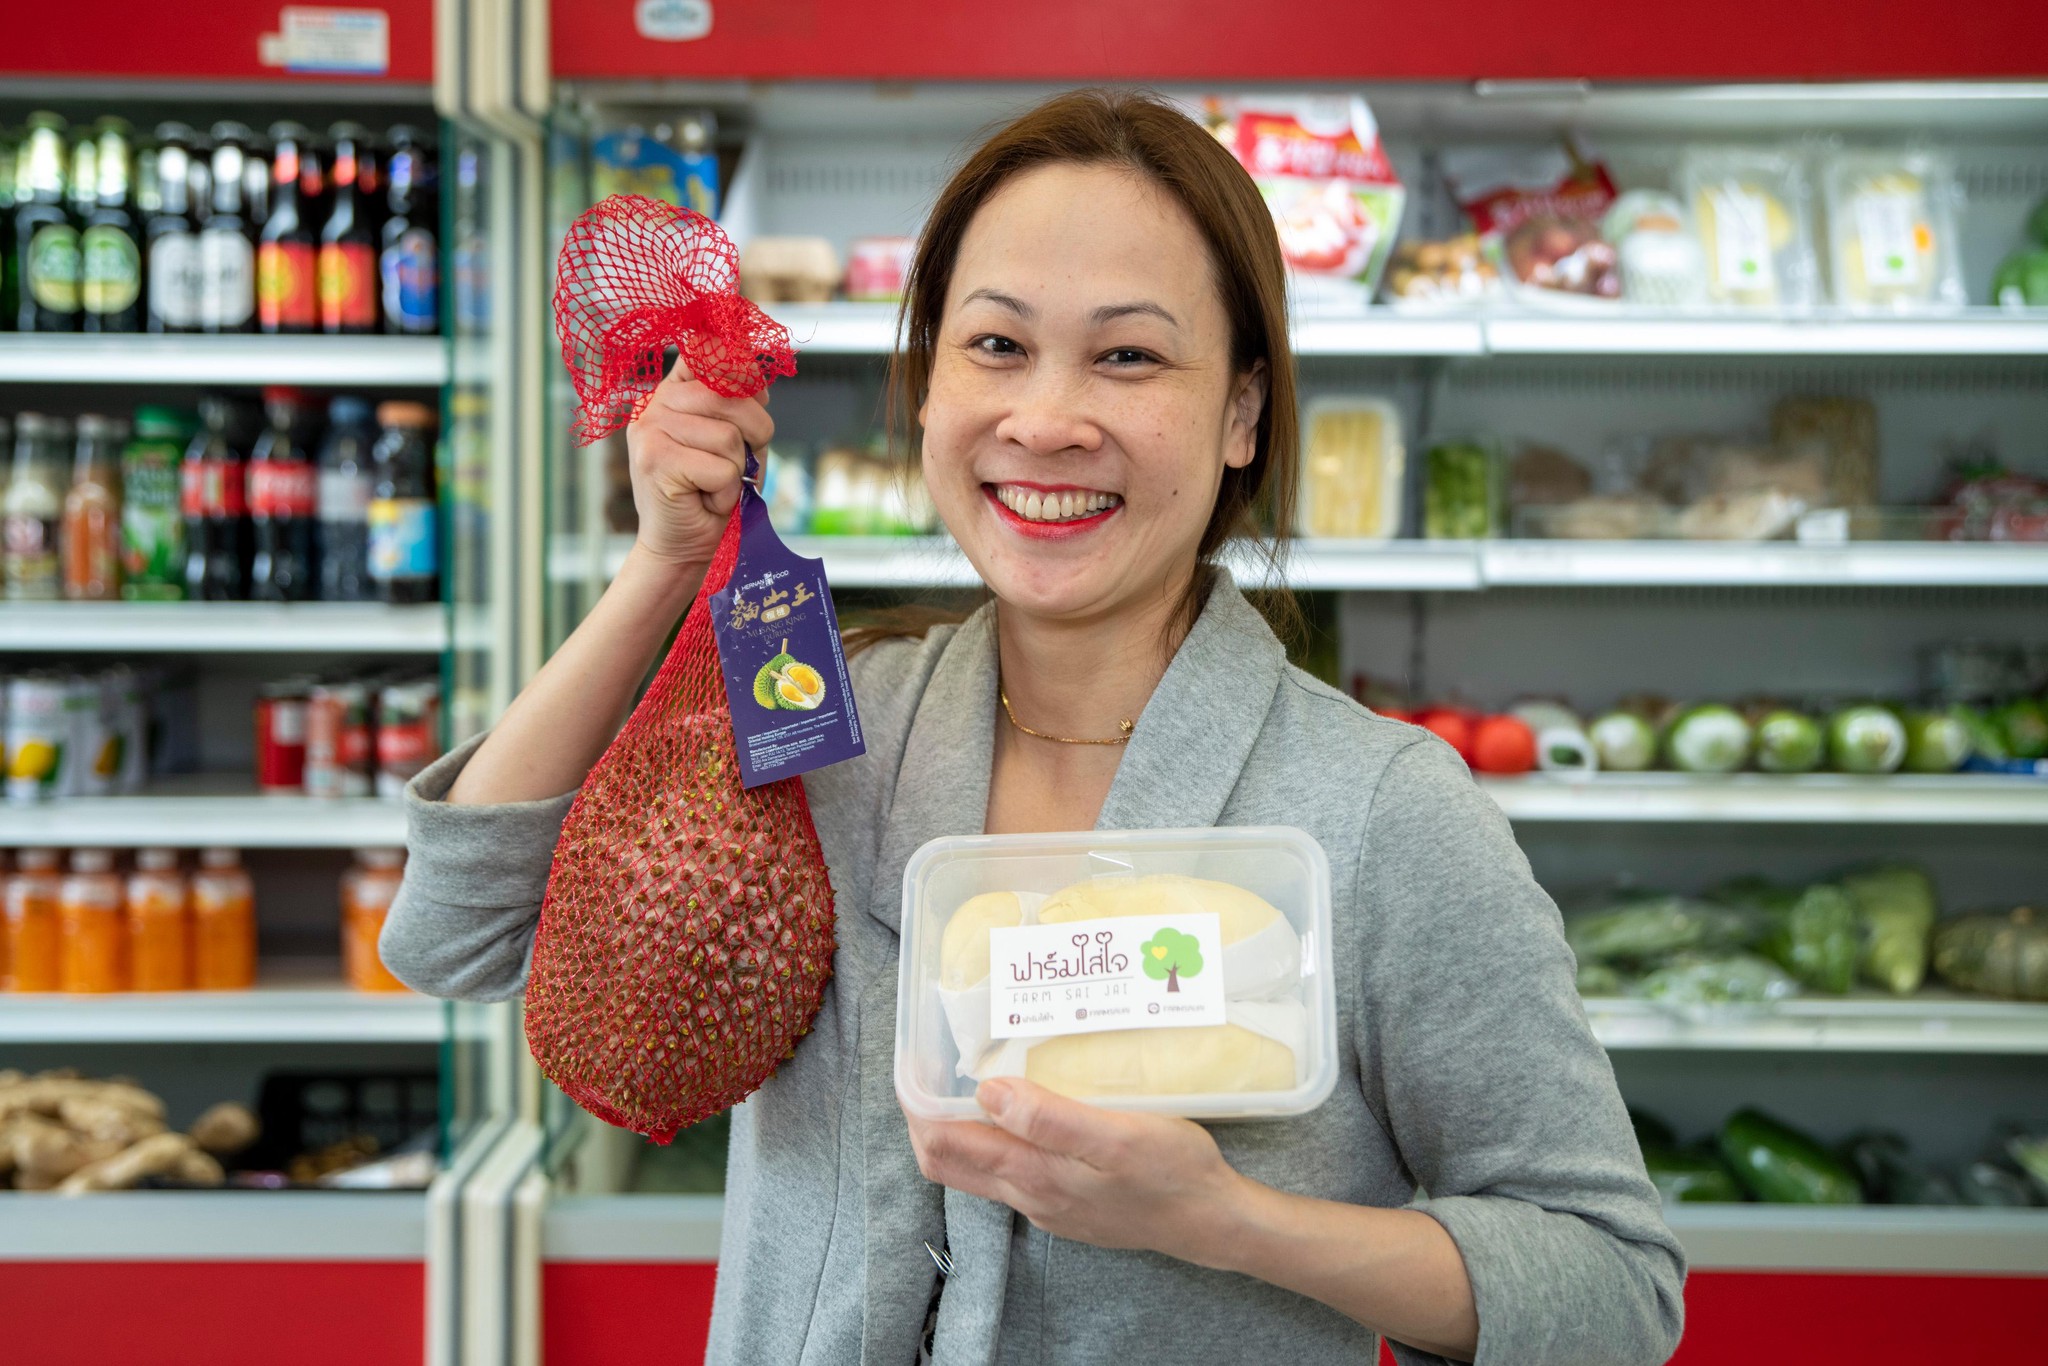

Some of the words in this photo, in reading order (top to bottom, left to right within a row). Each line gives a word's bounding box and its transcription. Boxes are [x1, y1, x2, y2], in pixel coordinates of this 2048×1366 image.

[741, 579, 765, 591] HERNAN
[773, 569, 790, 580] FOOD
[746, 620, 784, 639] MUSANG
[785, 613, 807, 627] KING
[763, 626, 794, 642] DURIAN
[1013, 991, 1053, 1005] FARM
[1065, 987, 1090, 1001] SAI
[1104, 983, 1129, 996] JAI
